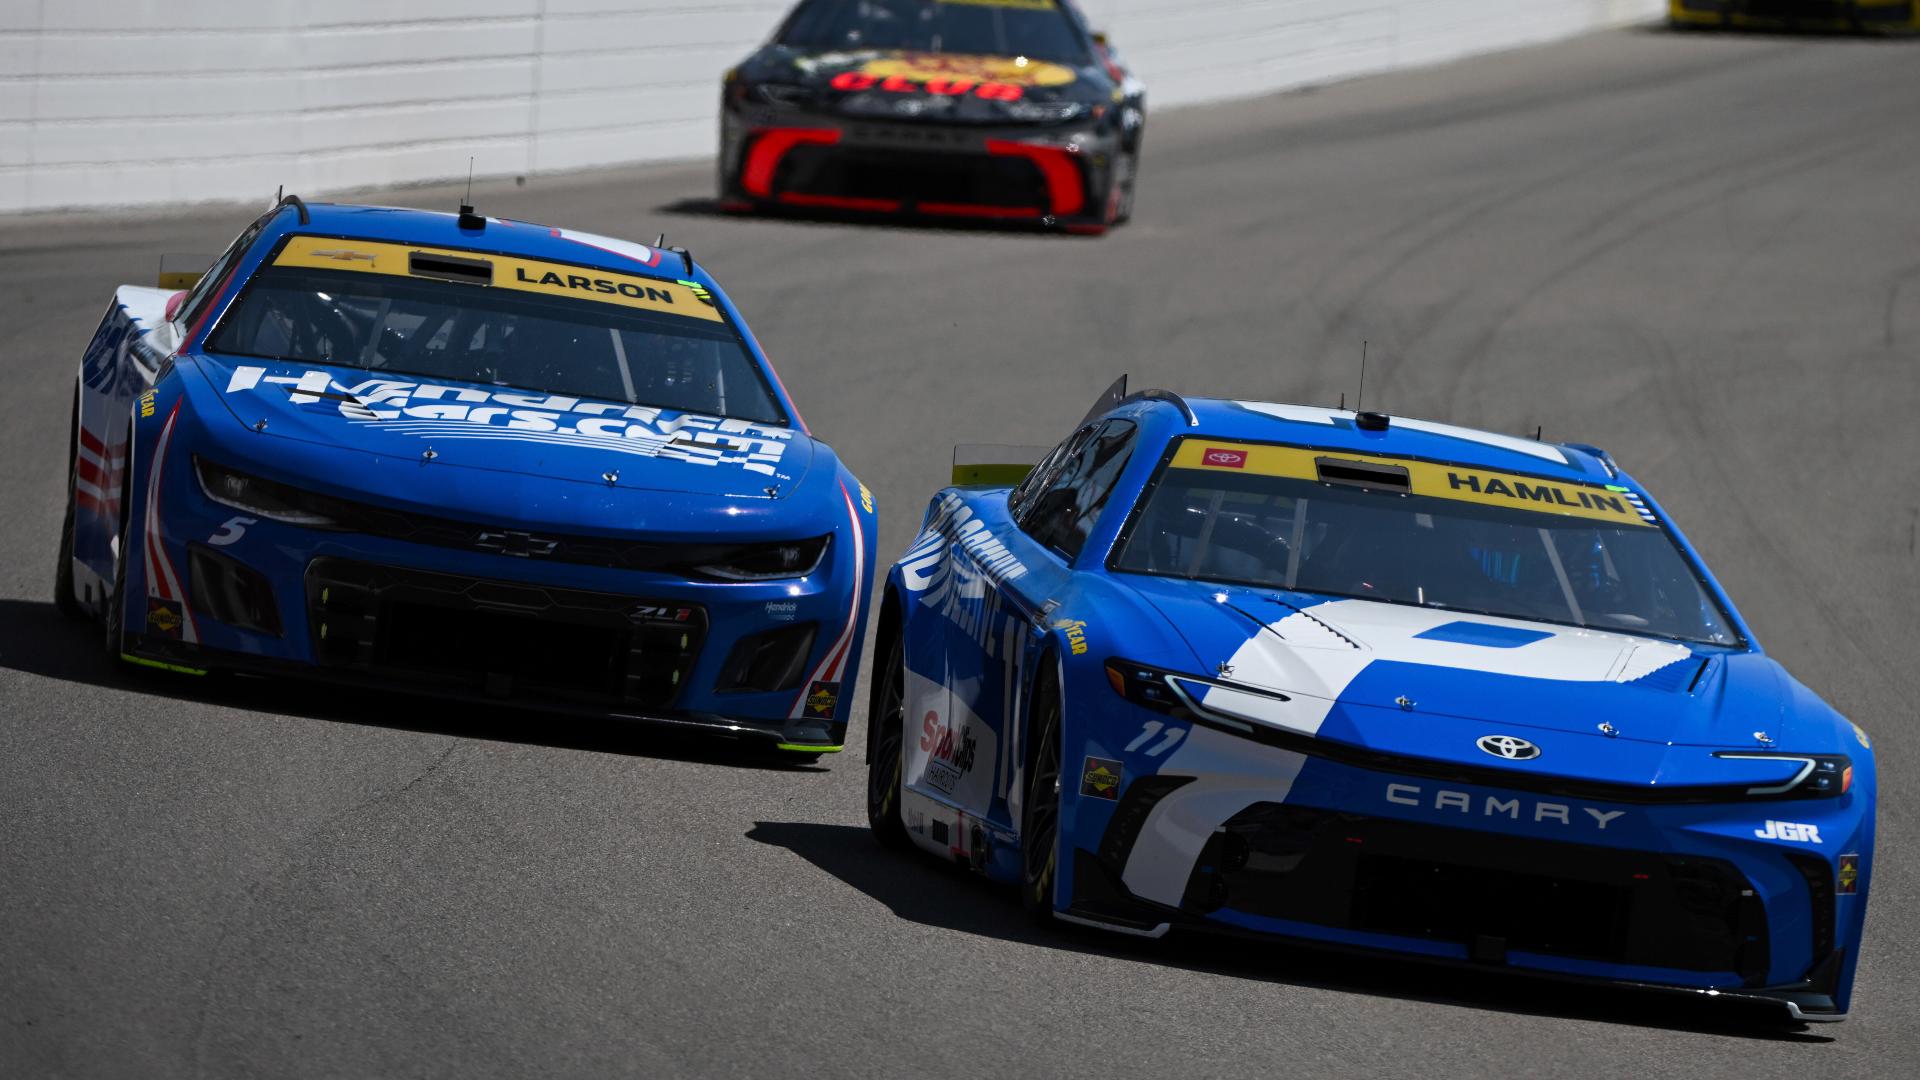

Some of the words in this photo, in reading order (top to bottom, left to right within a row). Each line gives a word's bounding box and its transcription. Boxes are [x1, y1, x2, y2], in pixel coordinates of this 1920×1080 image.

[516, 267, 674, 305] LARSON
[1447, 472, 1626, 514] HAMLIN
[208, 516, 258, 545] 5
[1123, 720, 1187, 757] 11
[1086, 770, 1120, 787] SUNOCO
[1386, 783, 1627, 829] CAMRY
[1754, 820, 1823, 844] JGR
